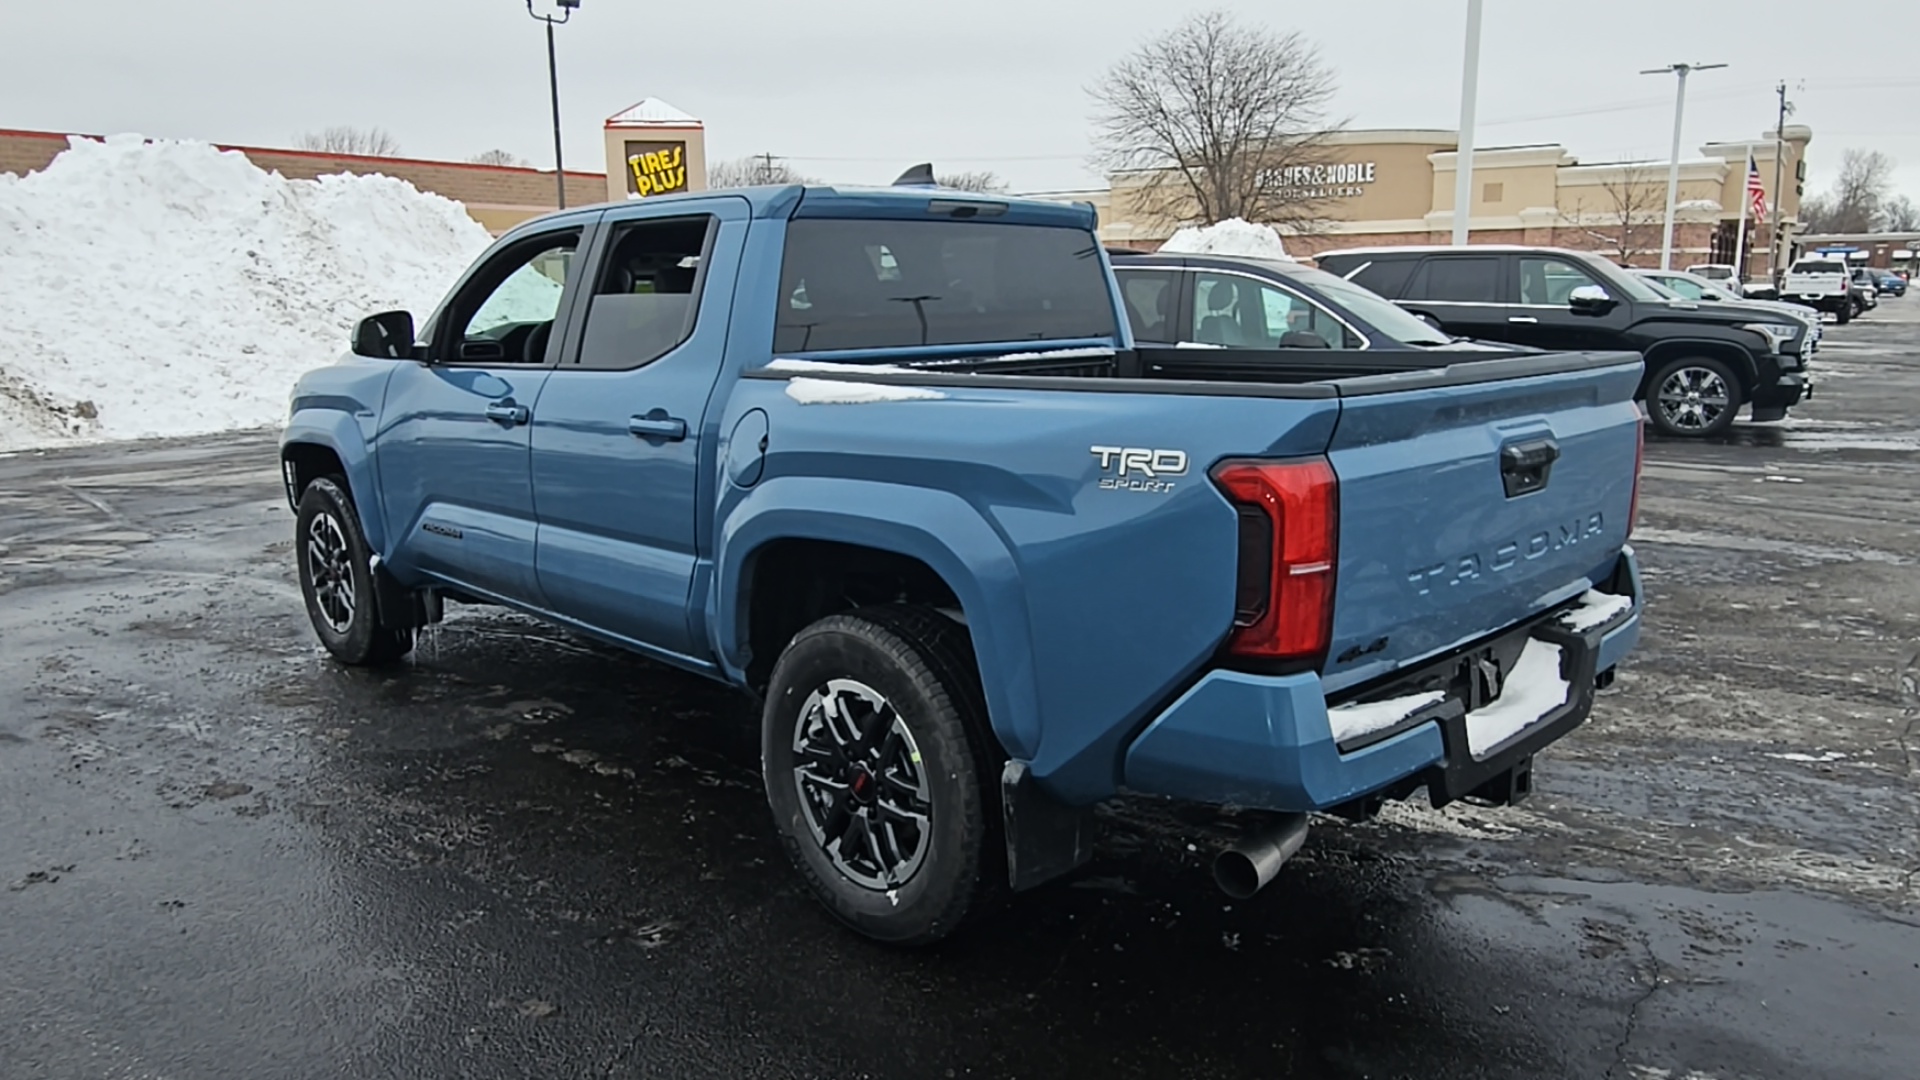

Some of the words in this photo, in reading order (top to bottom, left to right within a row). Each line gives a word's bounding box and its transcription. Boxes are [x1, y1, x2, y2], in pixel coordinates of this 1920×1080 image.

[628, 146, 681, 177] TIRES
[637, 166, 684, 196] PLUS
[1090, 445, 1187, 477] TRD
[1098, 478, 1175, 493] SPORT
[1408, 511, 1604, 595] TACOMA
